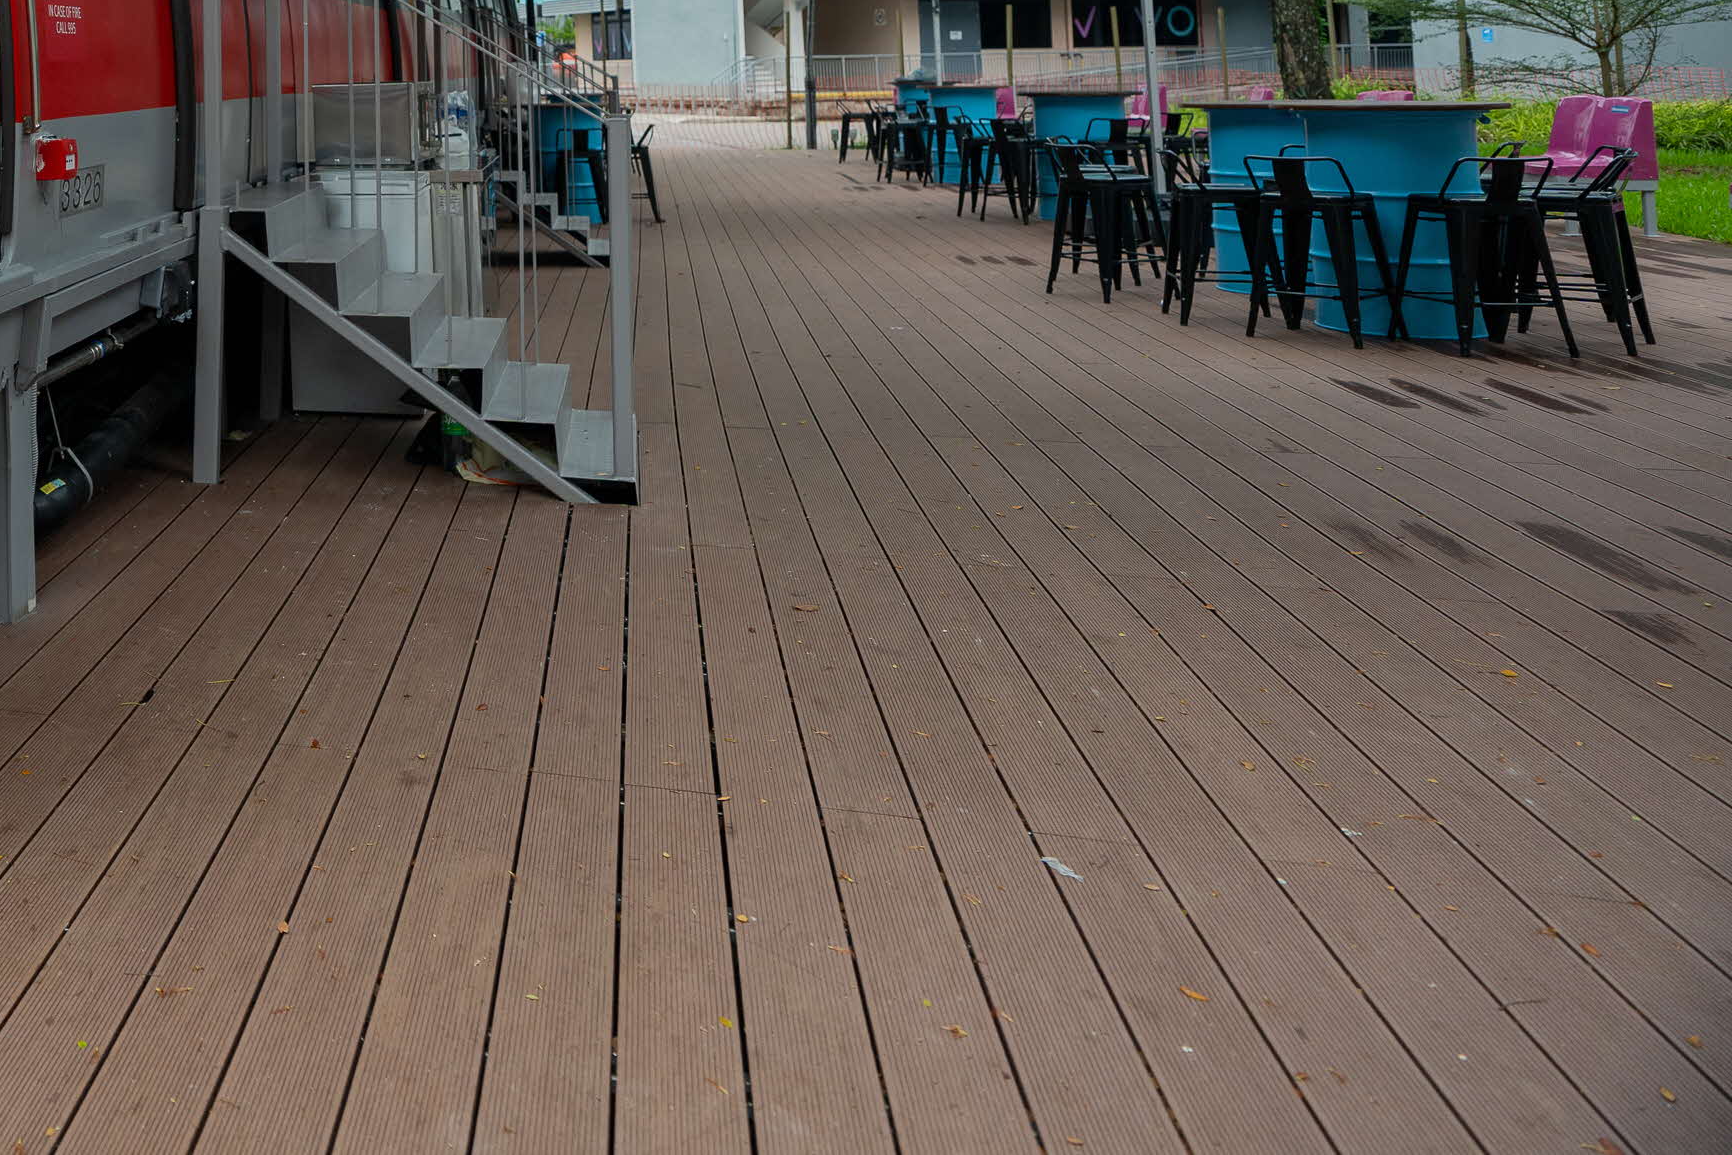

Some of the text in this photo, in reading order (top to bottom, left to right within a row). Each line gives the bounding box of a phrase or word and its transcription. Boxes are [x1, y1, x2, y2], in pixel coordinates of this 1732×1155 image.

[54, 4, 66, 18] CASE
[72, 6, 82, 19] FIRE
[56, 21, 68, 34] CALL
[61, 171, 102, 212] 3326
